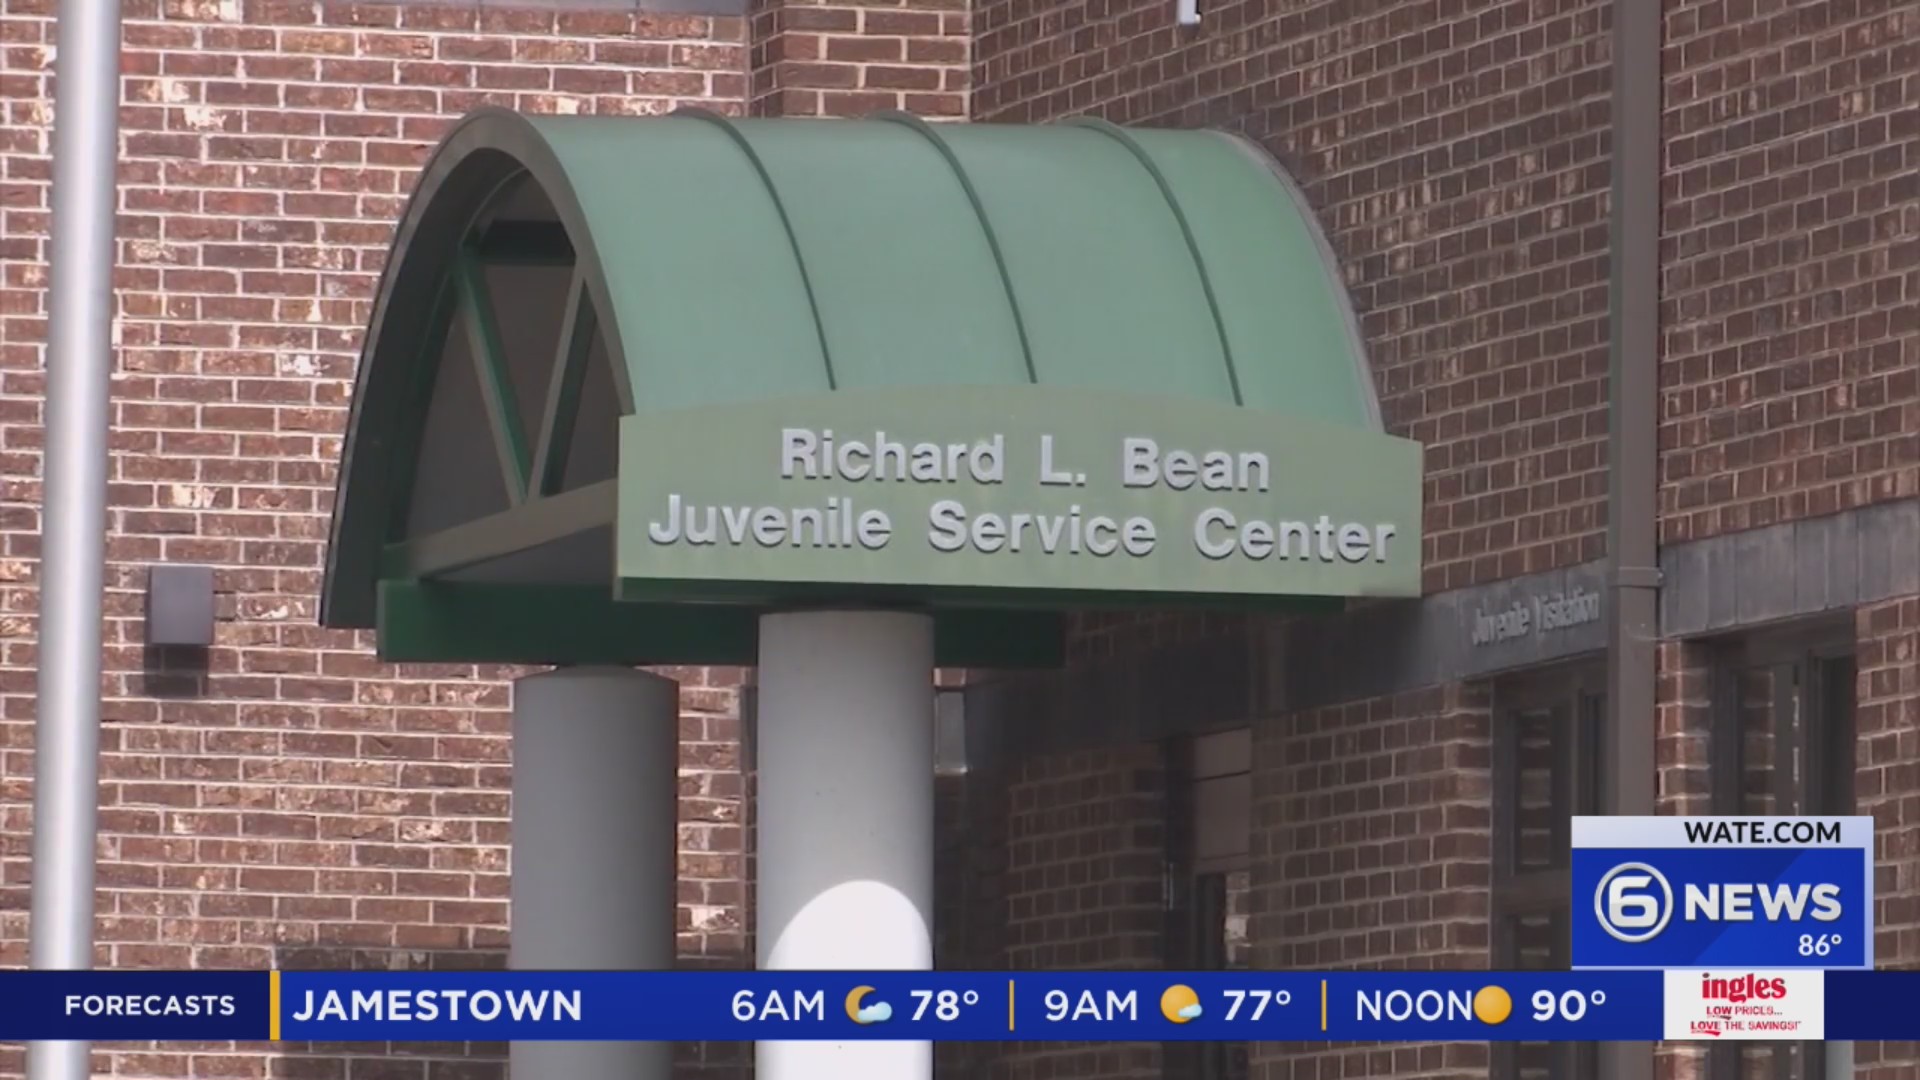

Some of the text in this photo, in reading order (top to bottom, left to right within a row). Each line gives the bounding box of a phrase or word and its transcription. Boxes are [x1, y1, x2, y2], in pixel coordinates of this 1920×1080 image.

[780, 428, 1270, 491] Richard L. Bean
[648, 494, 1396, 563] Juvenile Service Center
